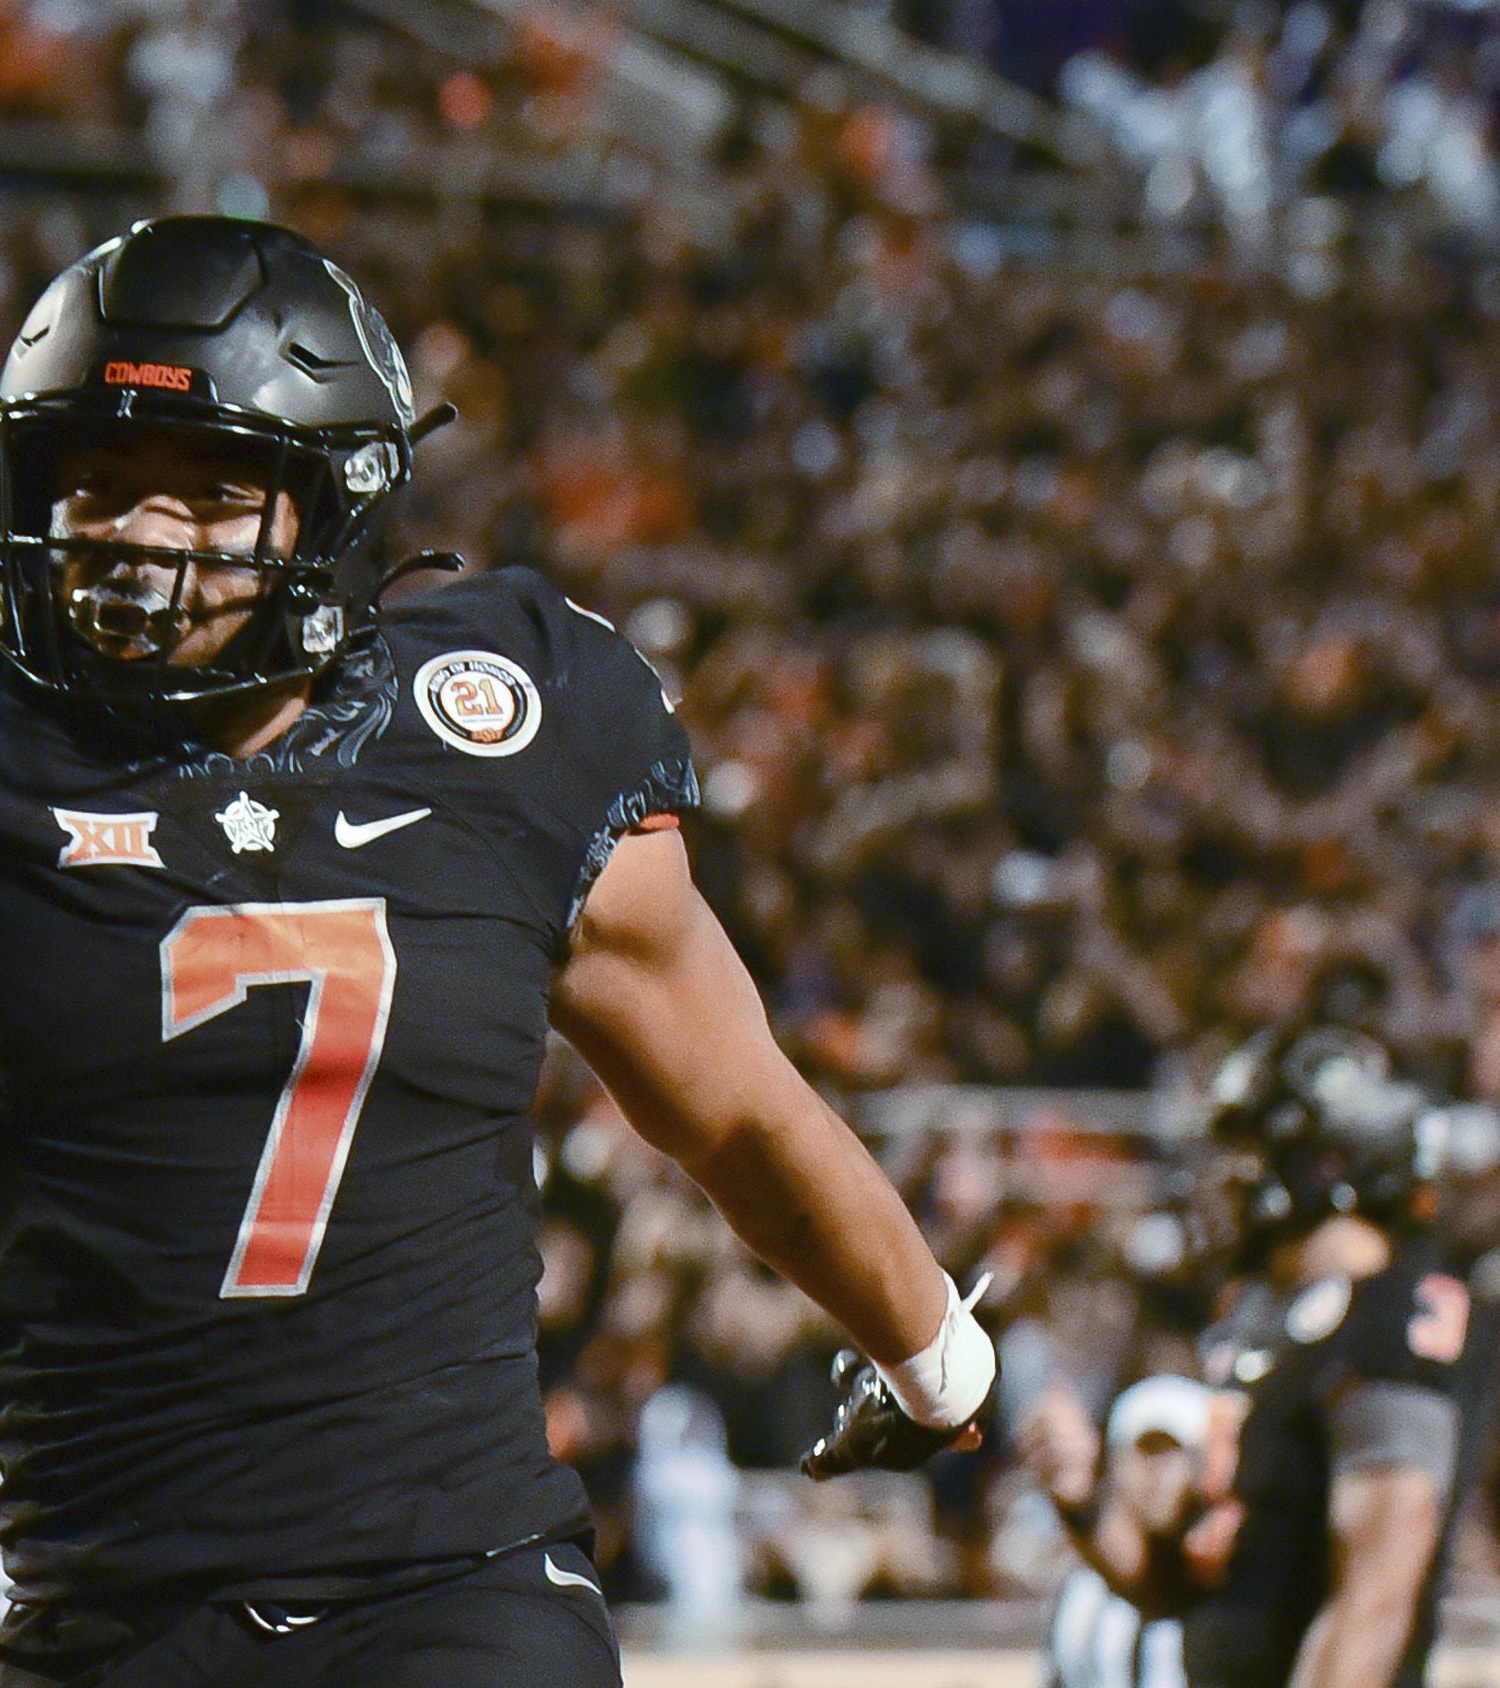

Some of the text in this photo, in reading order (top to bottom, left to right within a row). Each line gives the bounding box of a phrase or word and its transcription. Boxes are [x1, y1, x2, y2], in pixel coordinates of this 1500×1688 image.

[105, 361, 191, 391] COWBOYS
[451, 678, 504, 716] 21
[59, 812, 162, 865] XII
[159, 897, 398, 1299] 7
